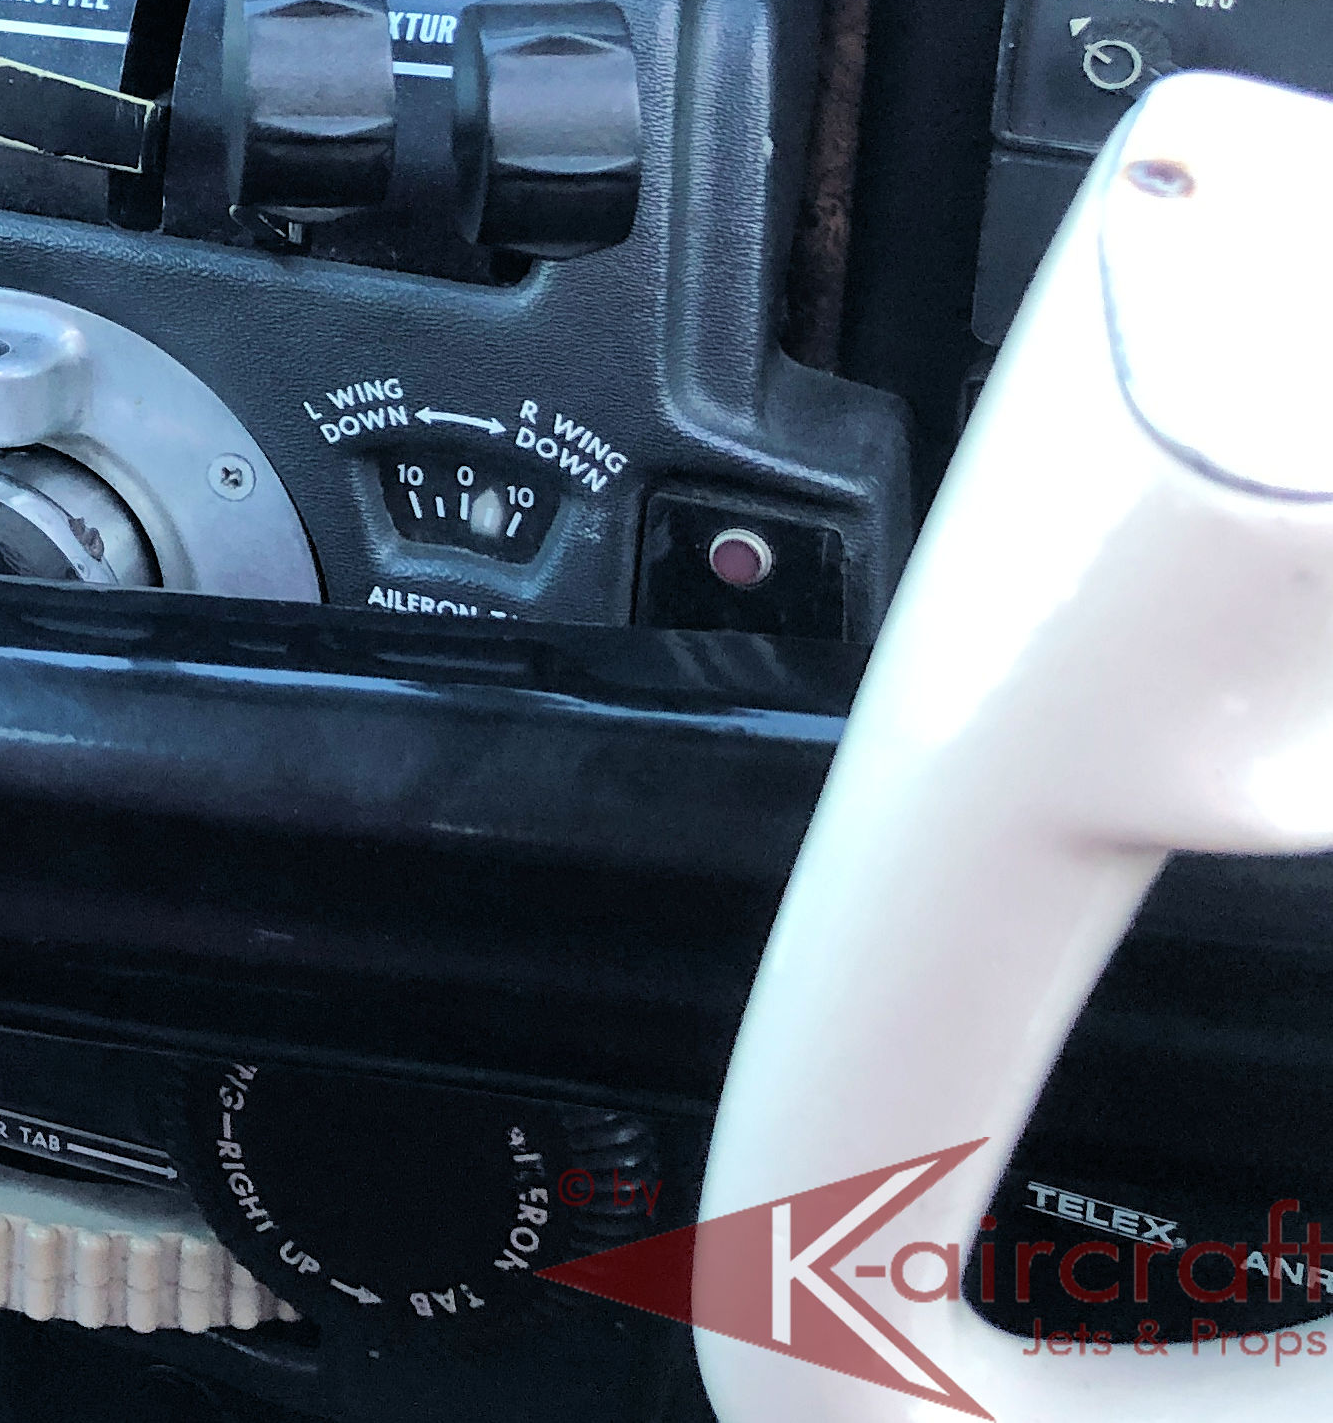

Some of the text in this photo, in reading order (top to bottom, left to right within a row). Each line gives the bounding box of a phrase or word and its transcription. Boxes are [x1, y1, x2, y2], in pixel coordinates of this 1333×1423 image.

[303, 378, 404, 421] L WING
[321, 406, 409, 444] DOWN
[520, 400, 630, 474] R WING
[516, 427, 607, 492] DOWN
[398, 465, 534, 508] 10 0 10
[19, 1127, 61, 1153] TAB
[1031, 1183, 1181, 1248] TELEX
[280, 1241, 321, 1275] UP
